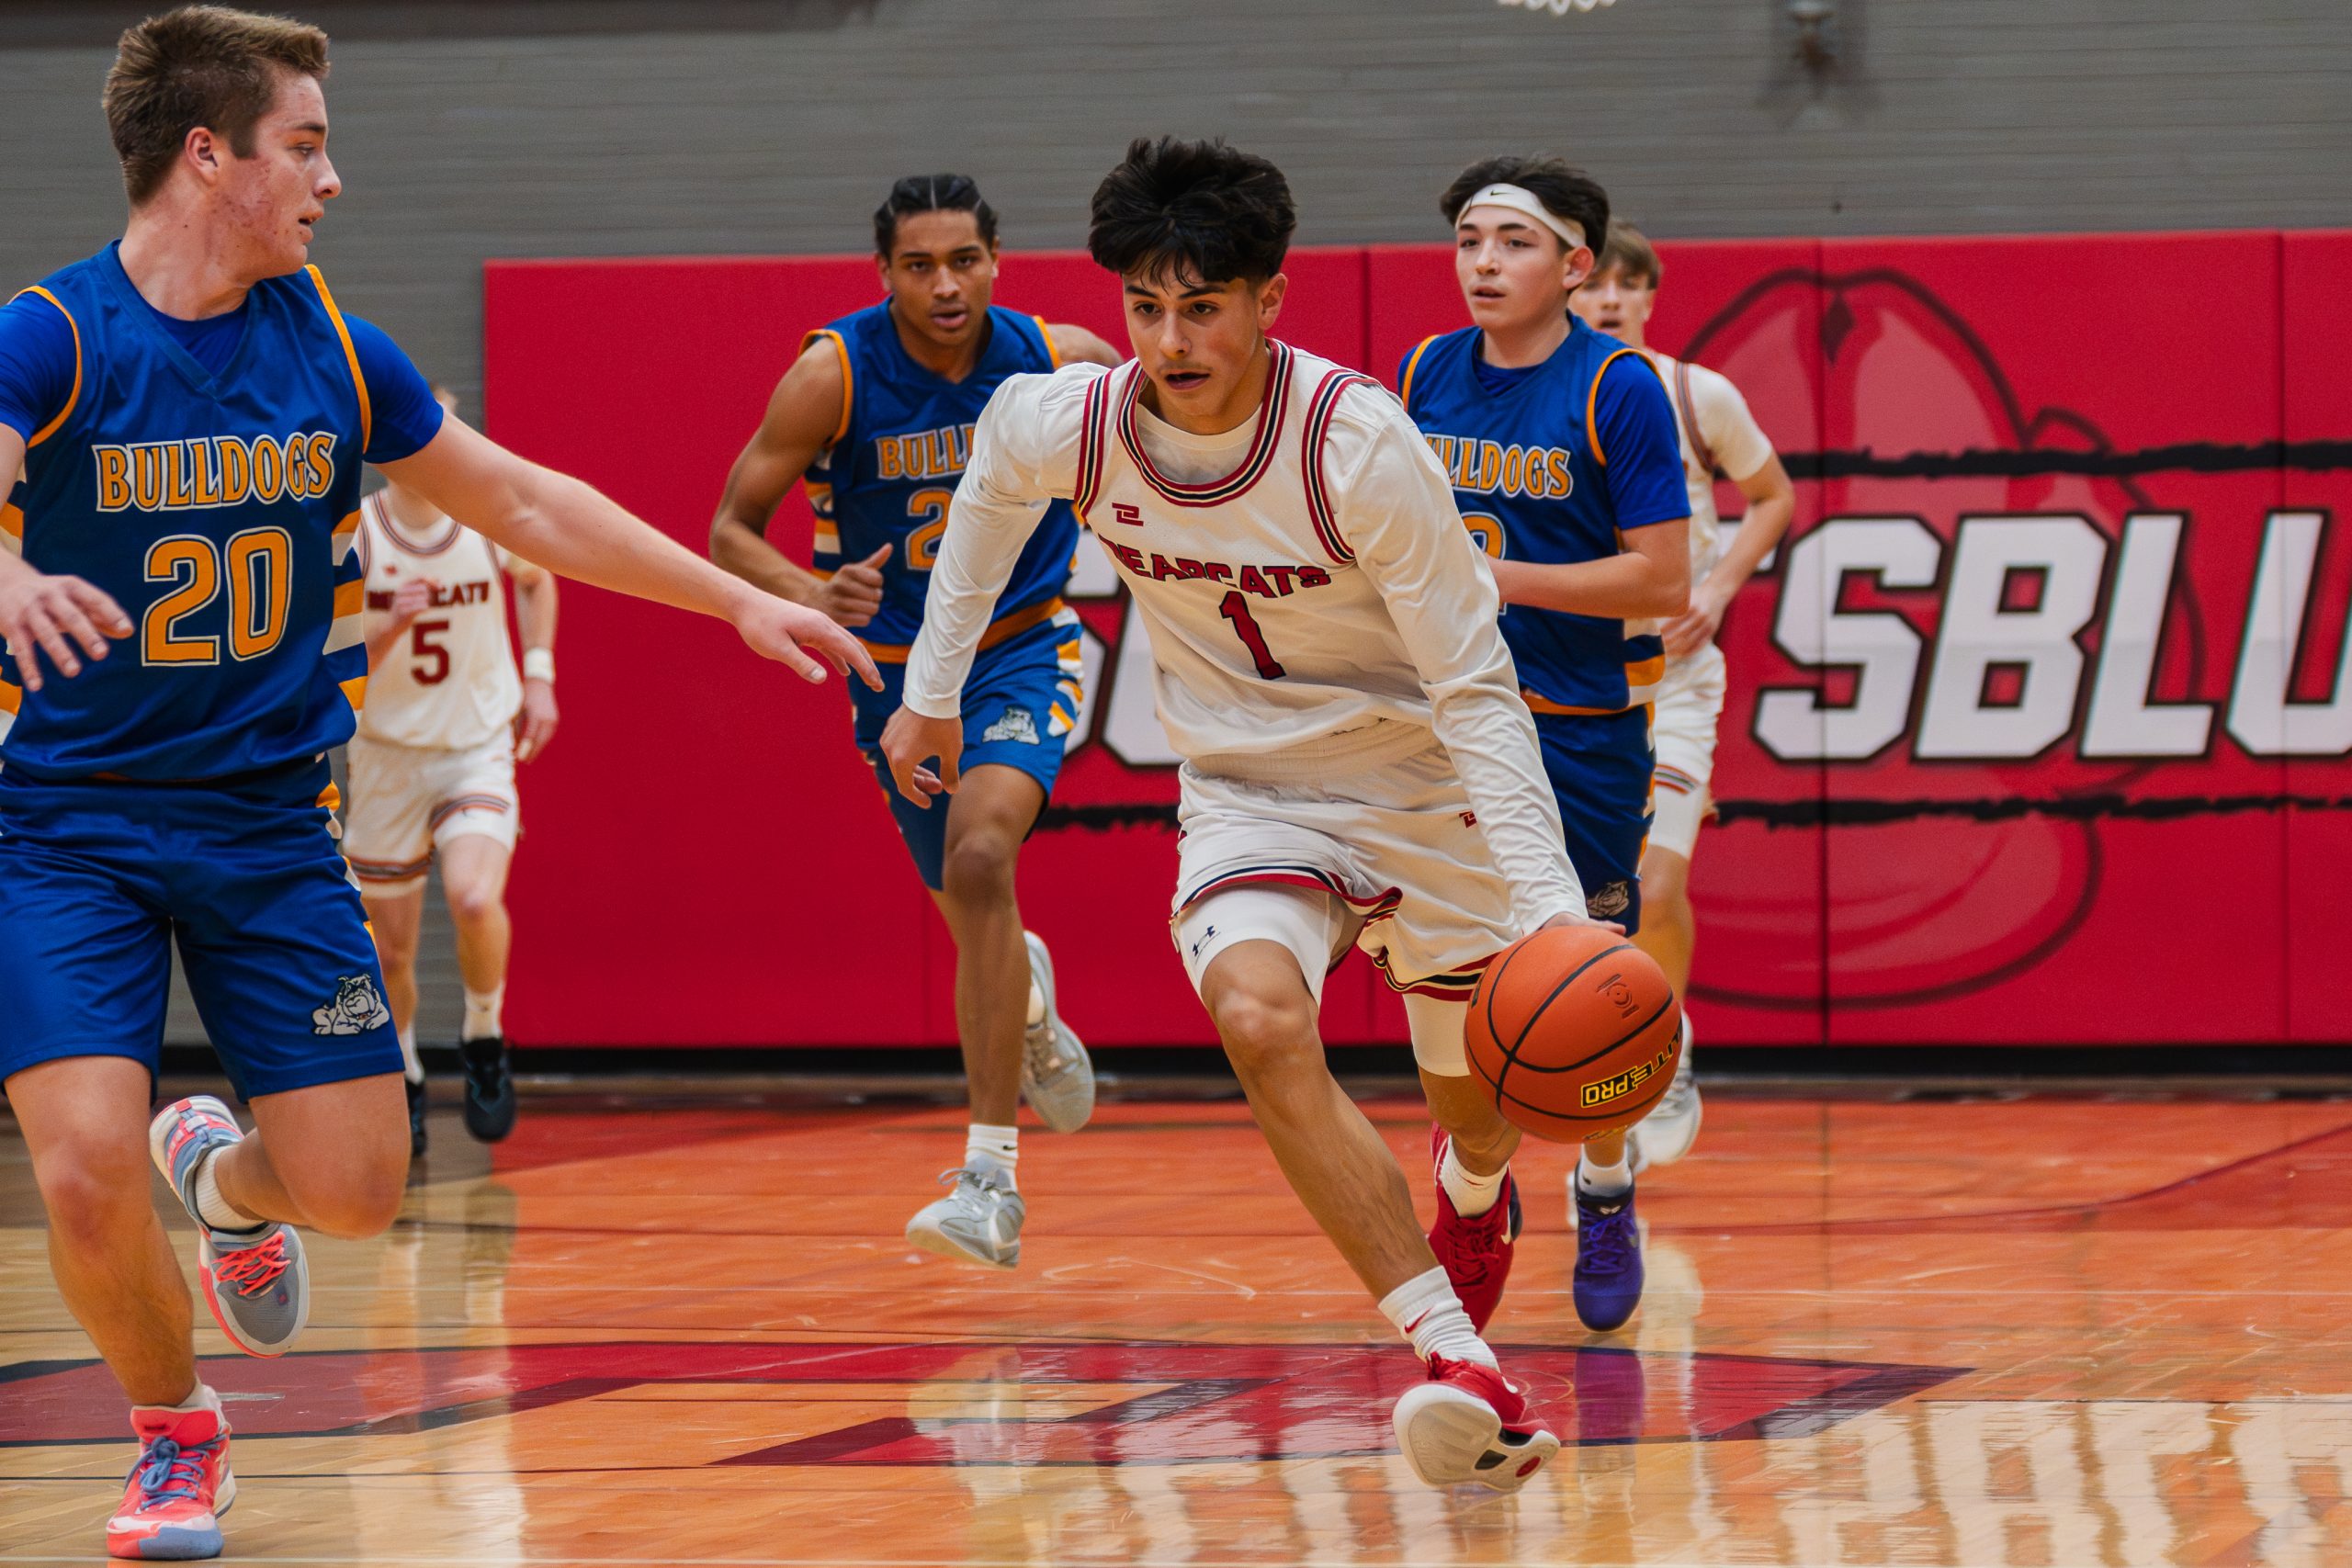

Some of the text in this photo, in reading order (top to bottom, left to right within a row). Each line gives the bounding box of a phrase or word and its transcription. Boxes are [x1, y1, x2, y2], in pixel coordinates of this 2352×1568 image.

[92, 431, 337, 512] BULLDOGS
[141, 525, 292, 667] 20
[1218, 591, 1286, 680] 1
[411, 619, 450, 687] 5
[1585, 1021, 1682, 1104] LITE PRO
